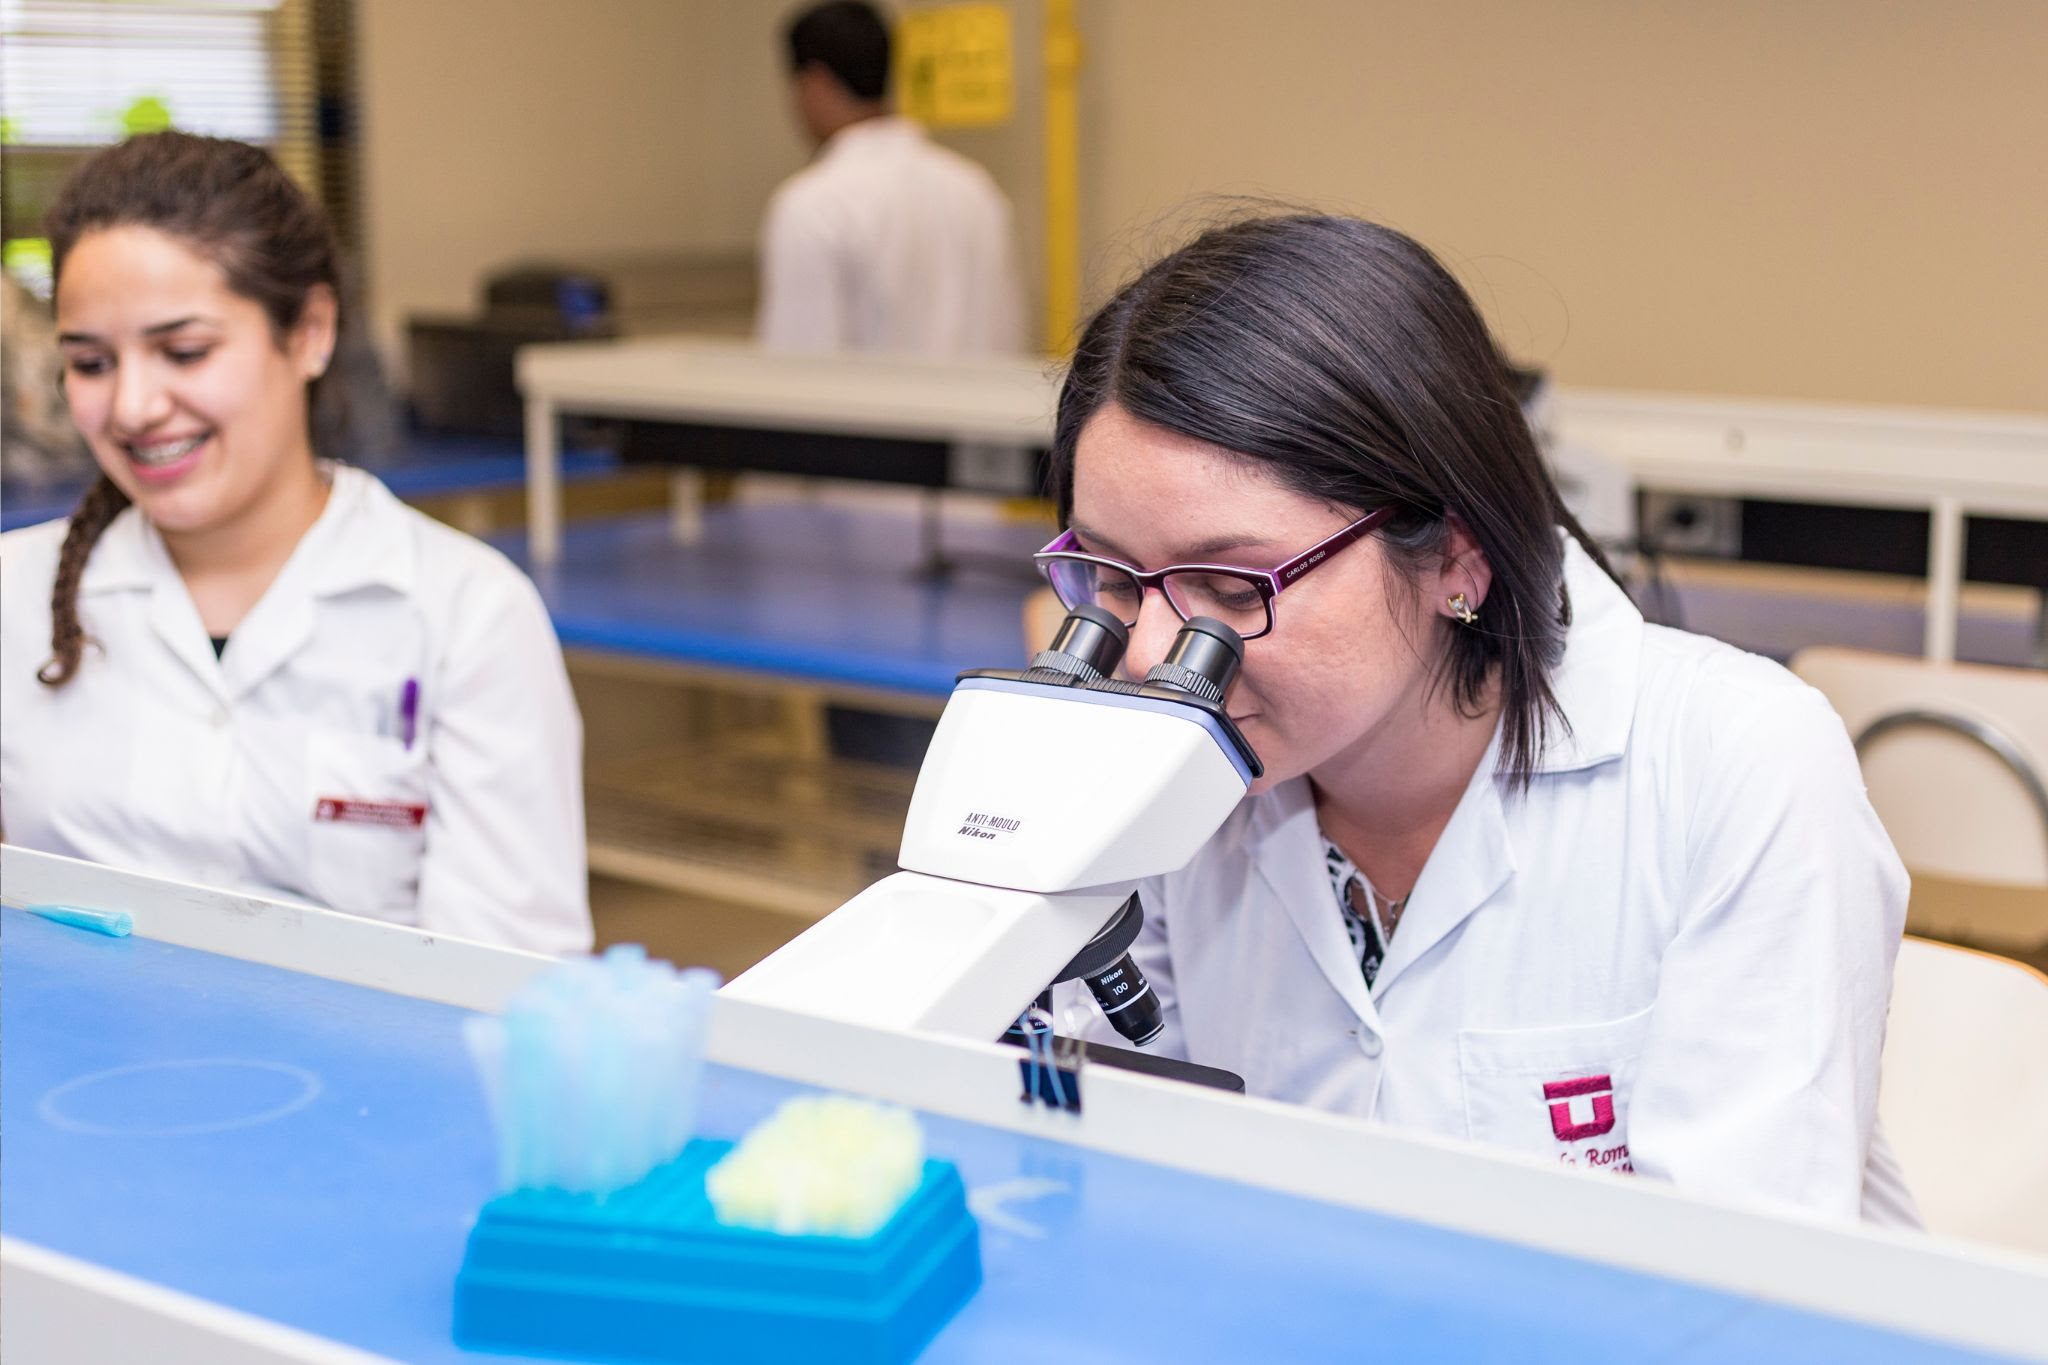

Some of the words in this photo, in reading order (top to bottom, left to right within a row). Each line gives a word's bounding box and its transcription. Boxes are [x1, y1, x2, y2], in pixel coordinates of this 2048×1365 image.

[1286, 561, 1308, 578] CARLOS
[1309, 550, 1326, 564] ROSSI
[965, 812, 1021, 831] ANTI-MOULD
[958, 826, 996, 840] Nikon
[1100, 968, 1124, 986] Nikon
[1112, 982, 1129, 996] 100
[1585, 1145, 1630, 1167] Rom
